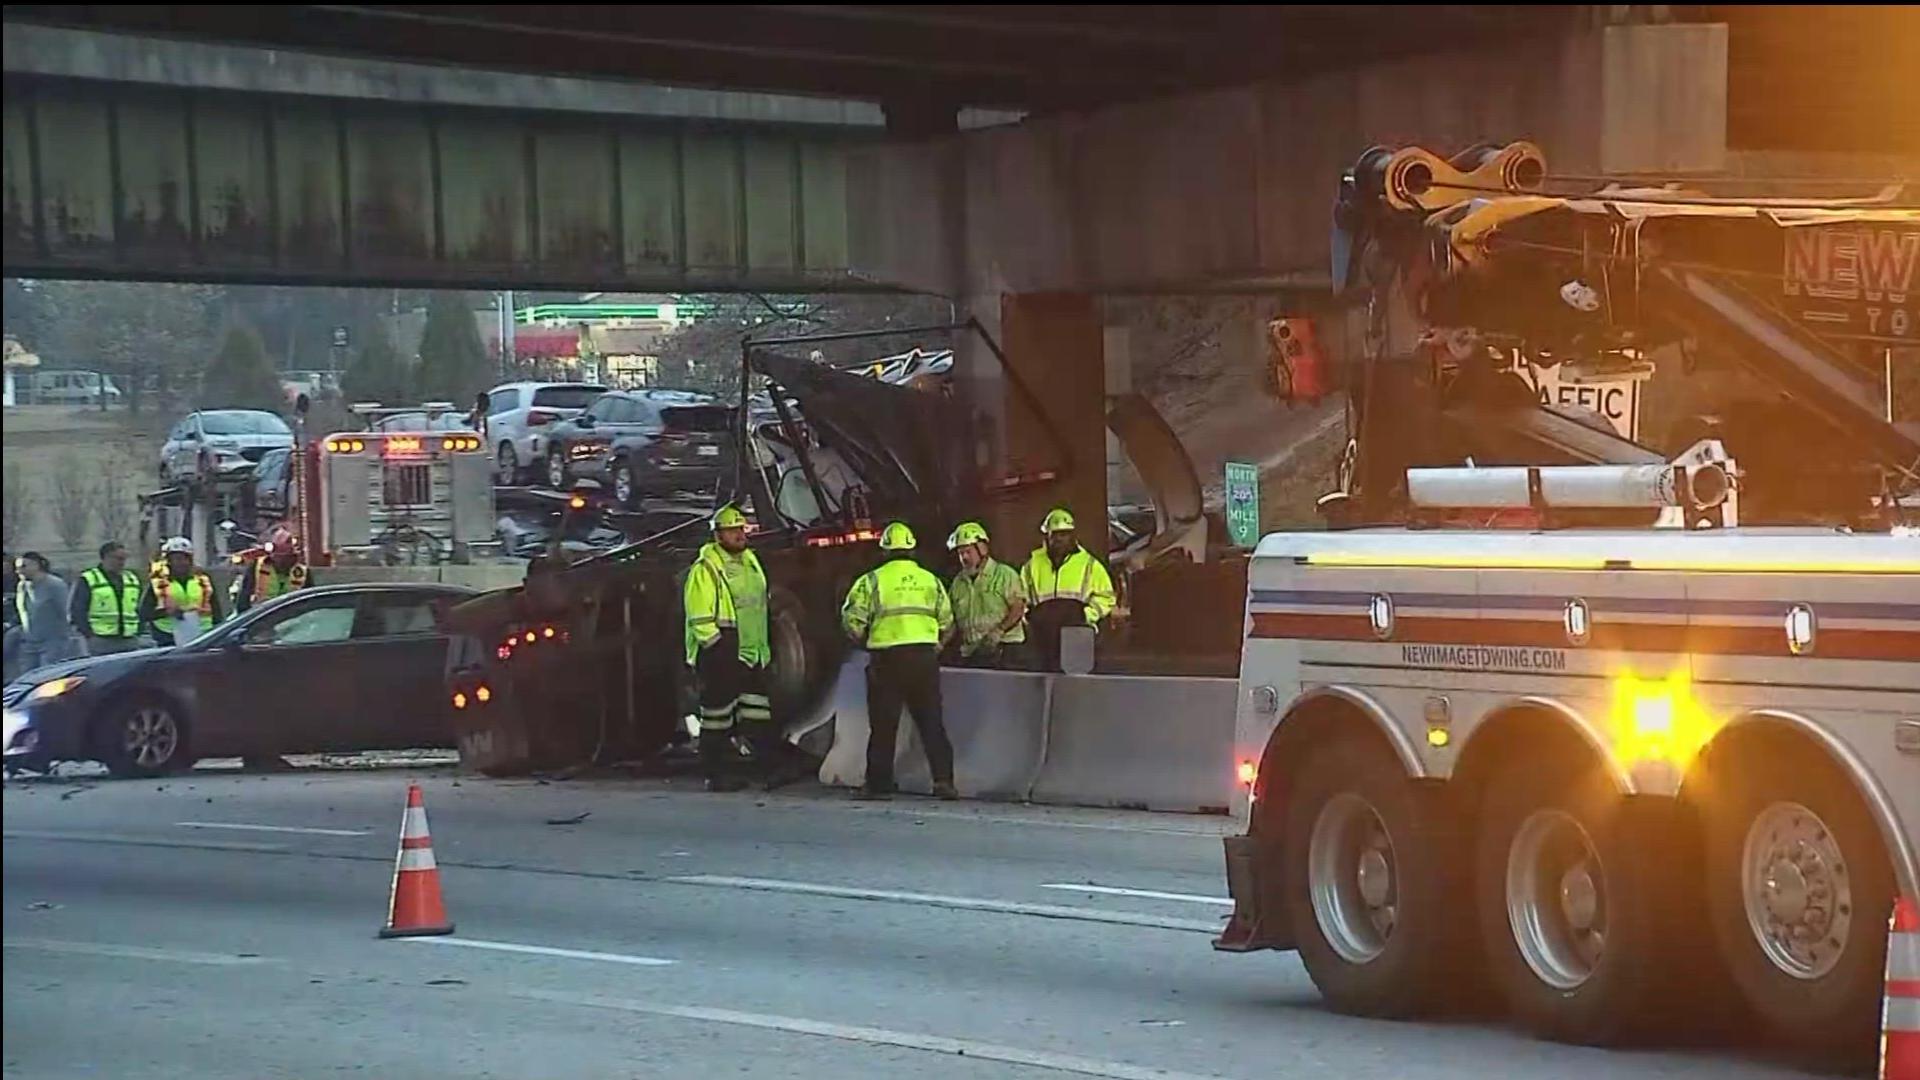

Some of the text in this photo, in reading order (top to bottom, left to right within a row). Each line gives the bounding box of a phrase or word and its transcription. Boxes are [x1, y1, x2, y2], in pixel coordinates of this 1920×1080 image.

[1783, 226, 1920, 303] NEW
[1867, 308, 1919, 335] TO
[1539, 385, 1624, 419] AFFIC
[1228, 468, 1256, 481] NORTH
[1230, 509, 1255, 521] MILE
[1239, 525, 1248, 538] 9
[1402, 645, 1566, 670] NEWIMAGETOWING.COM
